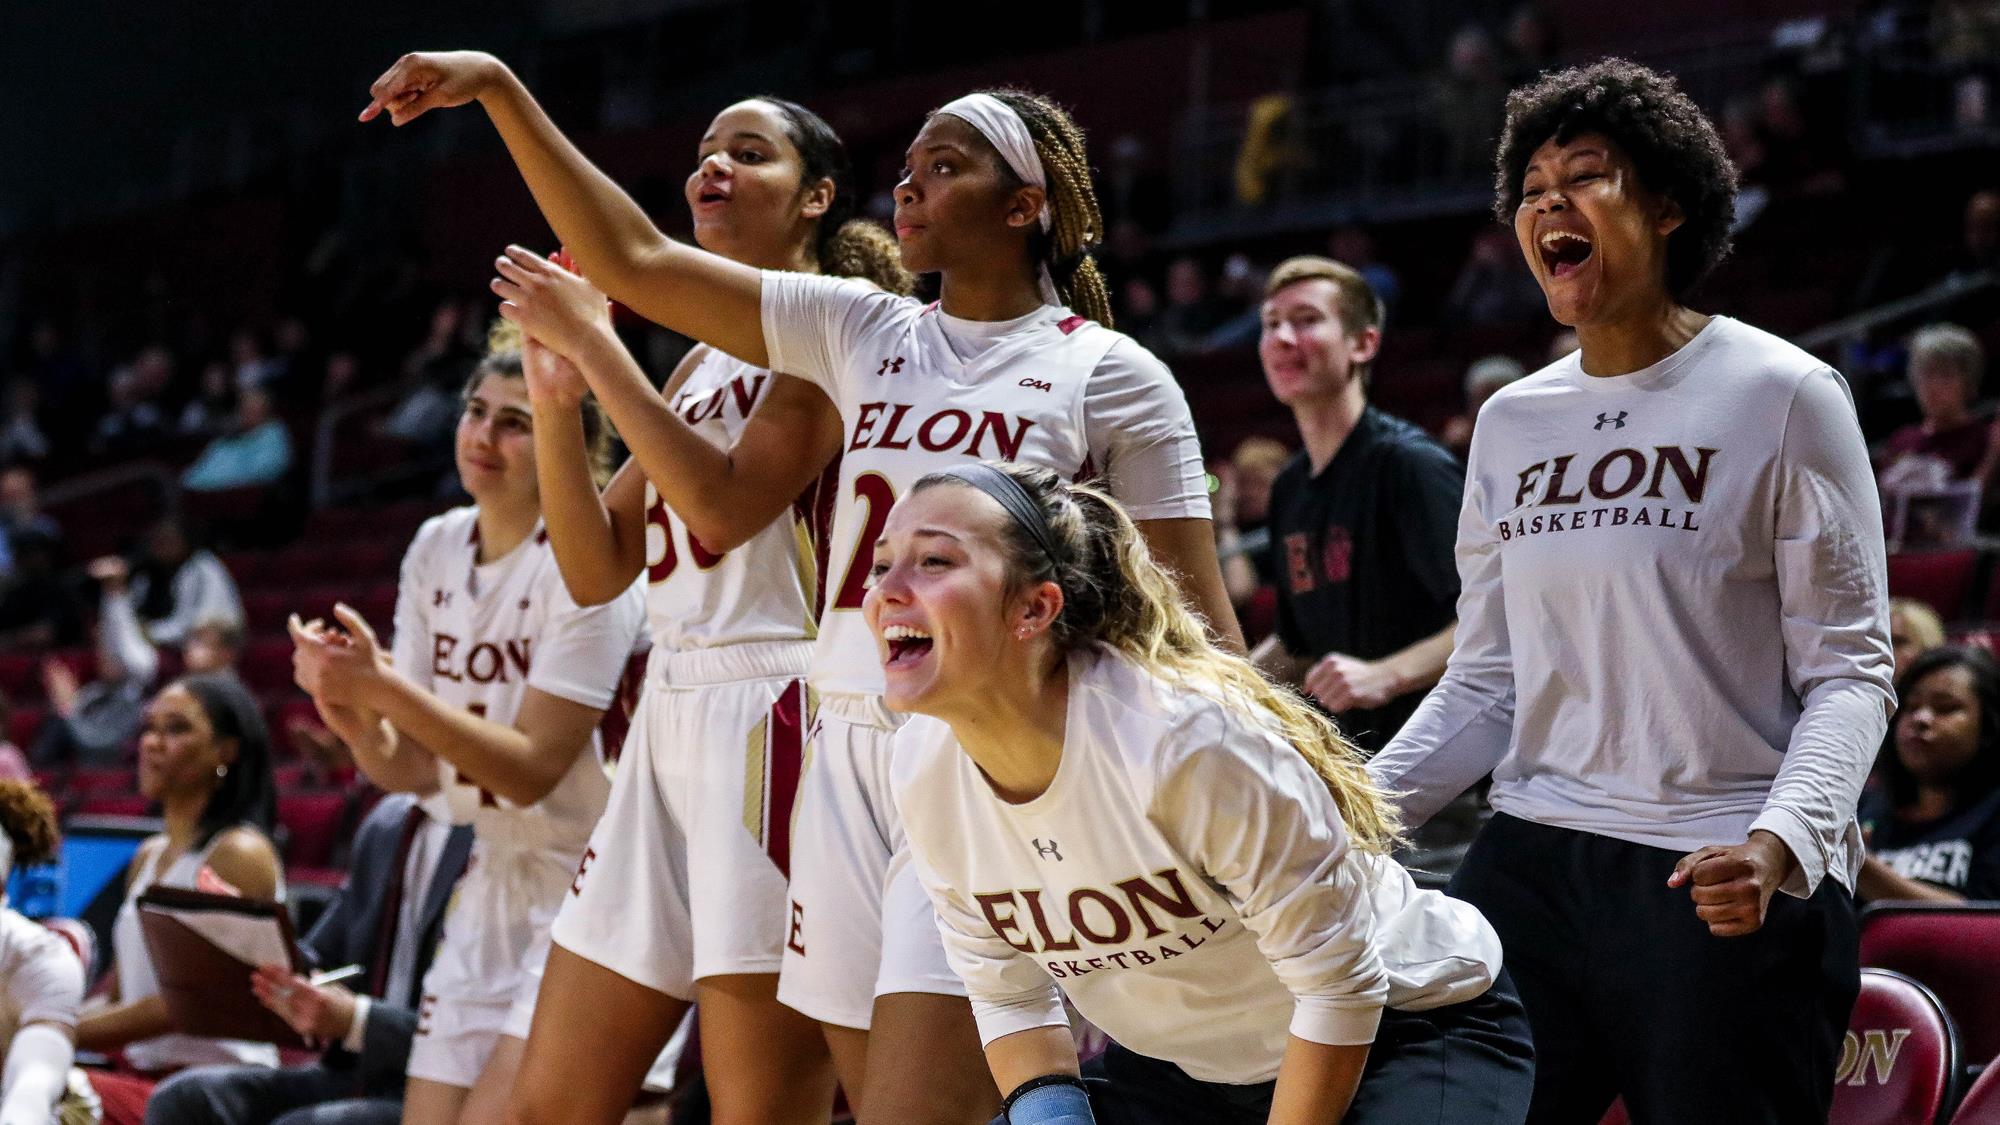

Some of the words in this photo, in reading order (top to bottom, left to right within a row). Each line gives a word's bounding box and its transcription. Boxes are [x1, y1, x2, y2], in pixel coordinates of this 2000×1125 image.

[1018, 377, 1052, 393] CAA
[847, 402, 1036, 463] ELON
[1514, 446, 1722, 509] ELON
[1499, 507, 1700, 542] BASKETBALL
[432, 632, 532, 683] EON
[787, 899, 806, 958] E
[974, 867, 1206, 954] ELON
[1047, 916, 1226, 979] SKETBALL
